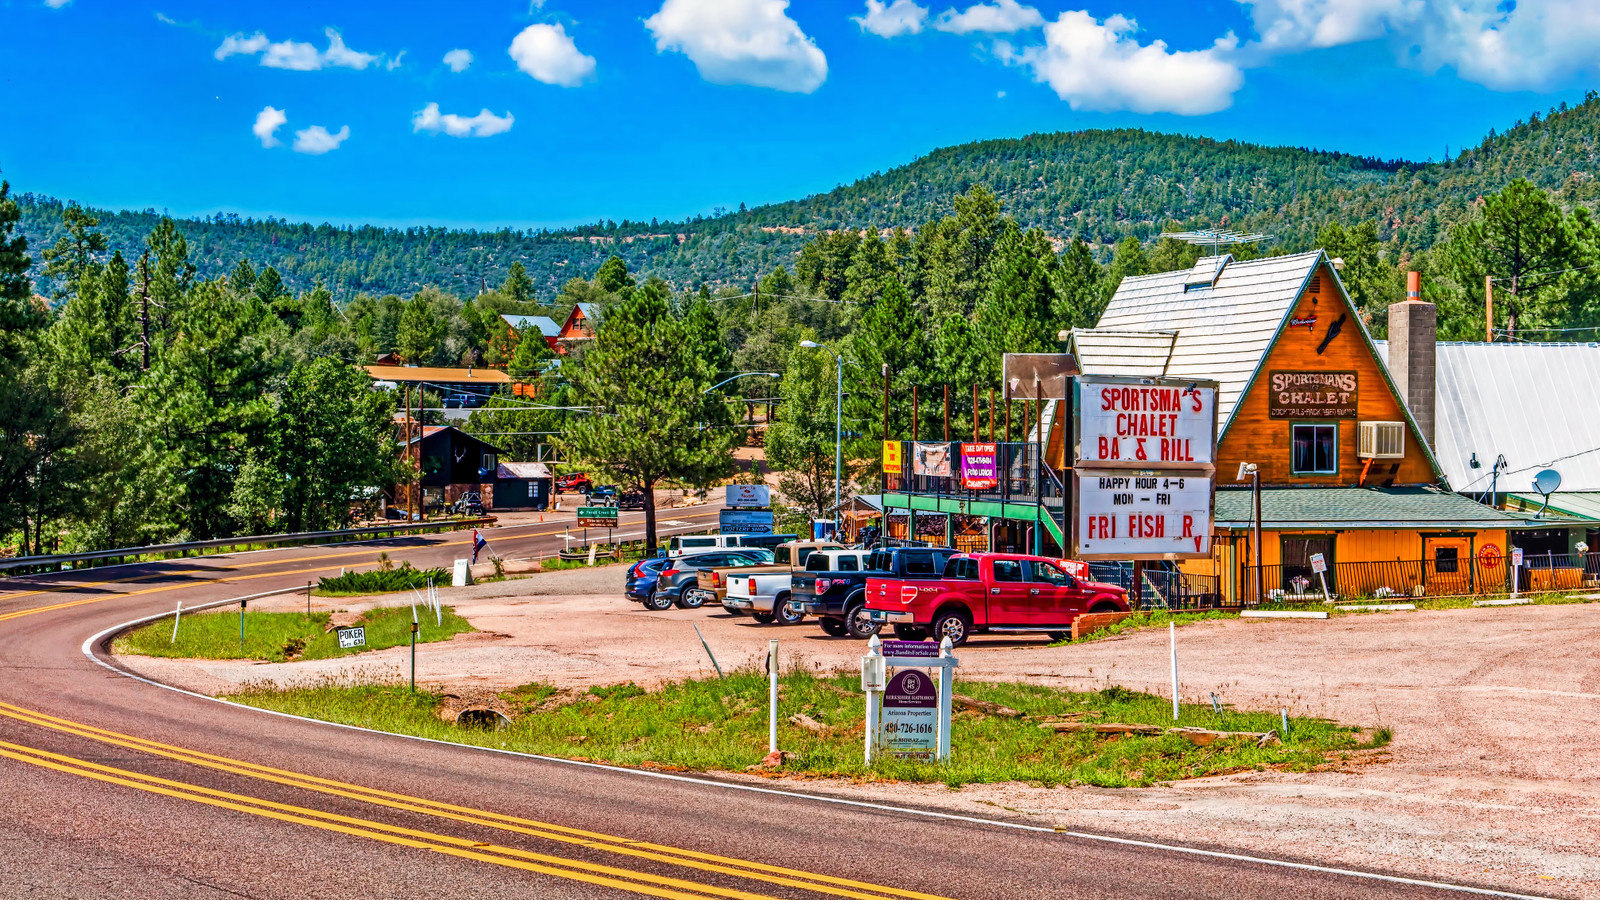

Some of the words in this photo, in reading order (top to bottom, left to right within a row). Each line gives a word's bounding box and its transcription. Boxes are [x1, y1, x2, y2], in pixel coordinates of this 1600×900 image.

[1272, 373, 1356, 391] SPORTSMANS
[1279, 391, 1350, 404] CHALET
[1116, 413, 1178, 437] CHALET
[1135, 437, 1148, 461] &
[1161, 438, 1194, 462] RILL
[1099, 477, 1130, 490] HAPPY
[1135, 477, 1158, 490] HOUR
[1113, 493, 1134, 505] MON
[1156, 493, 1171, 505] FRI
[1088, 515, 1116, 539] FRI
[1128, 515, 1165, 538] FISH
[340, 629, 363, 640] POKER
[885, 722, 933, 733] 480-726-1616
